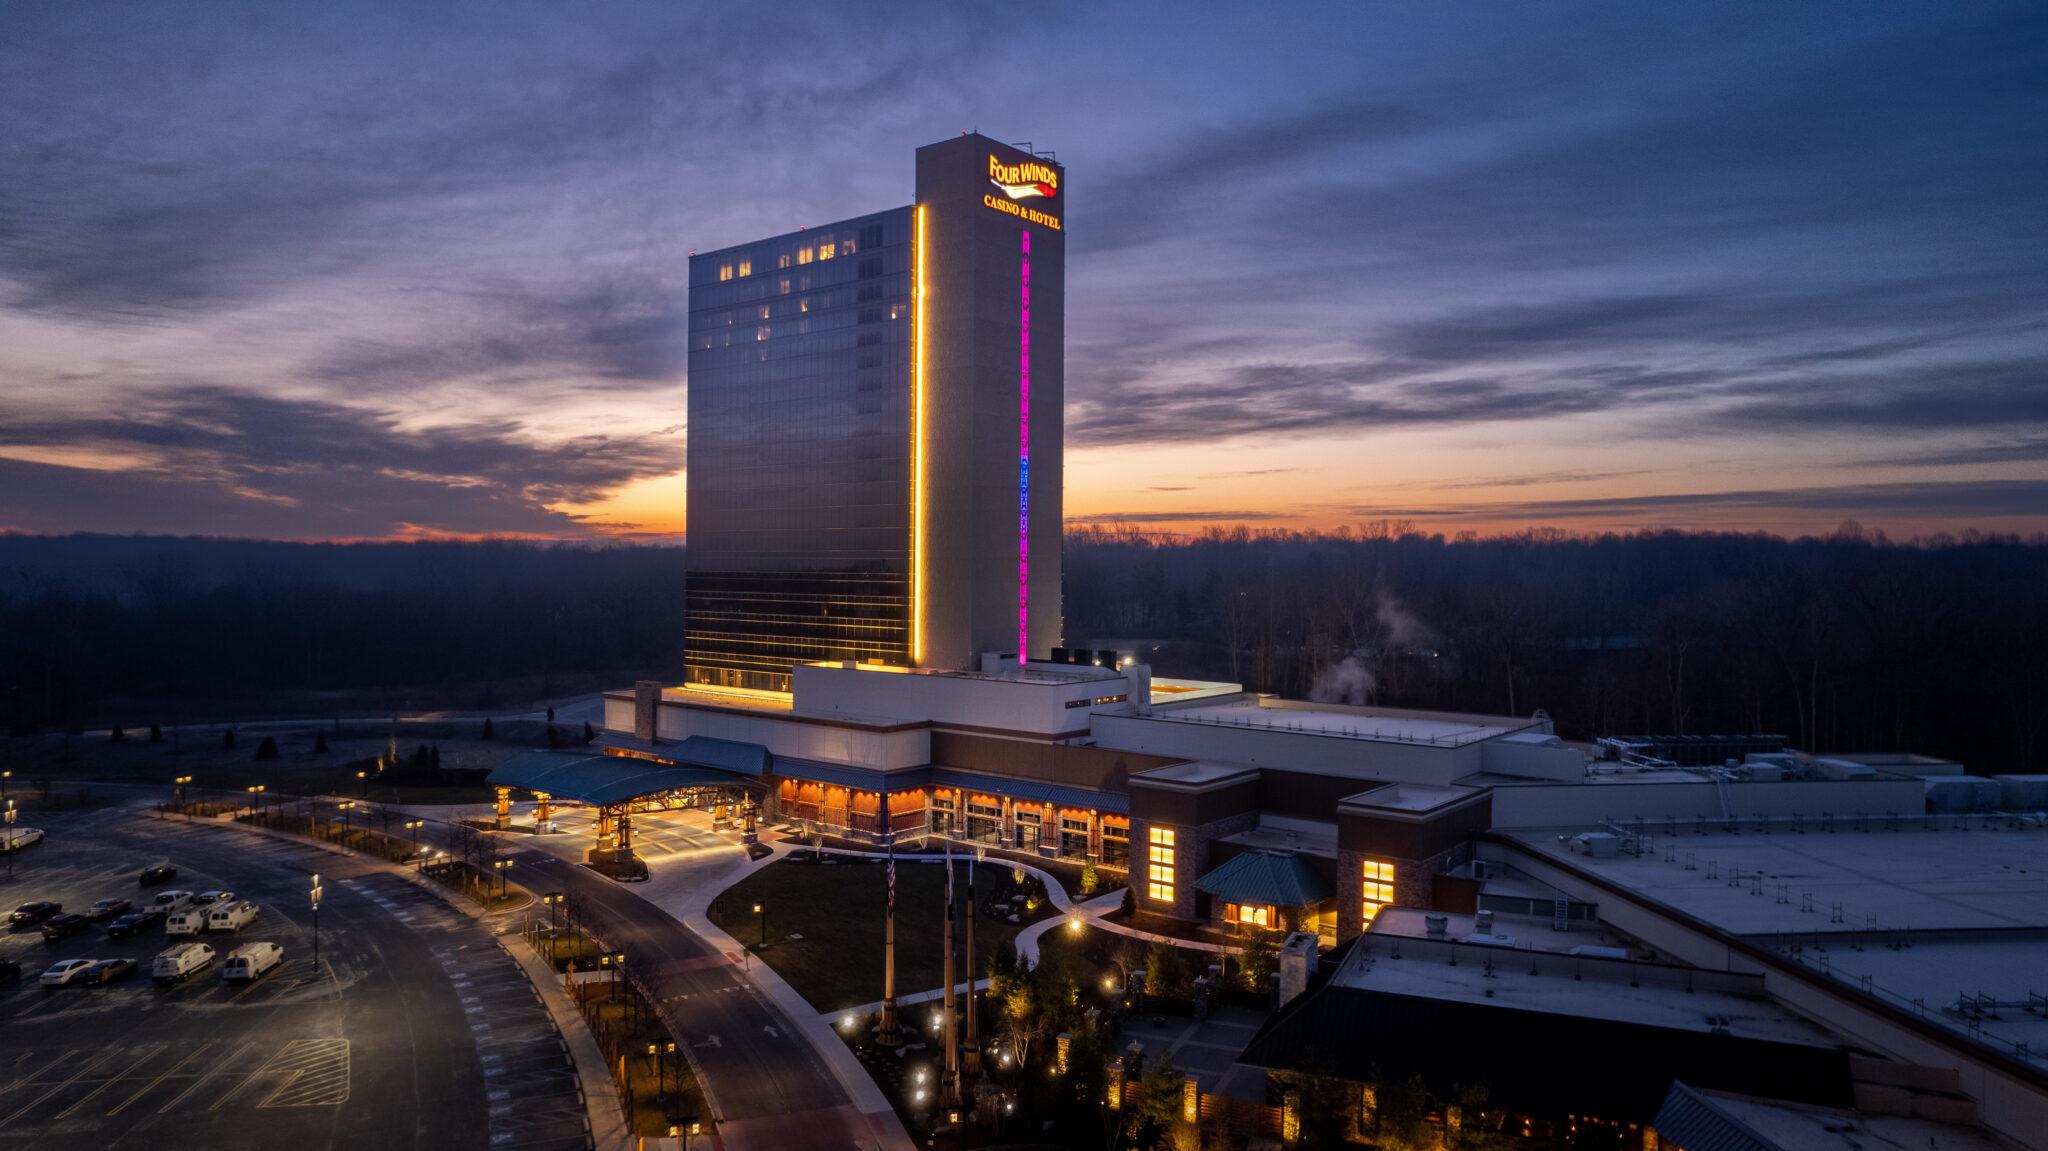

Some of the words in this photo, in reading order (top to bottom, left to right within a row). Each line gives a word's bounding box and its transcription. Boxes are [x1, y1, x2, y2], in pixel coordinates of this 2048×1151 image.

[989, 154, 1020, 184] FOUR
[1020, 162, 1057, 189] WINDS
[983, 194, 1020, 216] CASINO
[1020, 206, 1028, 219] &
[1029, 208, 1062, 230] HOTEL
